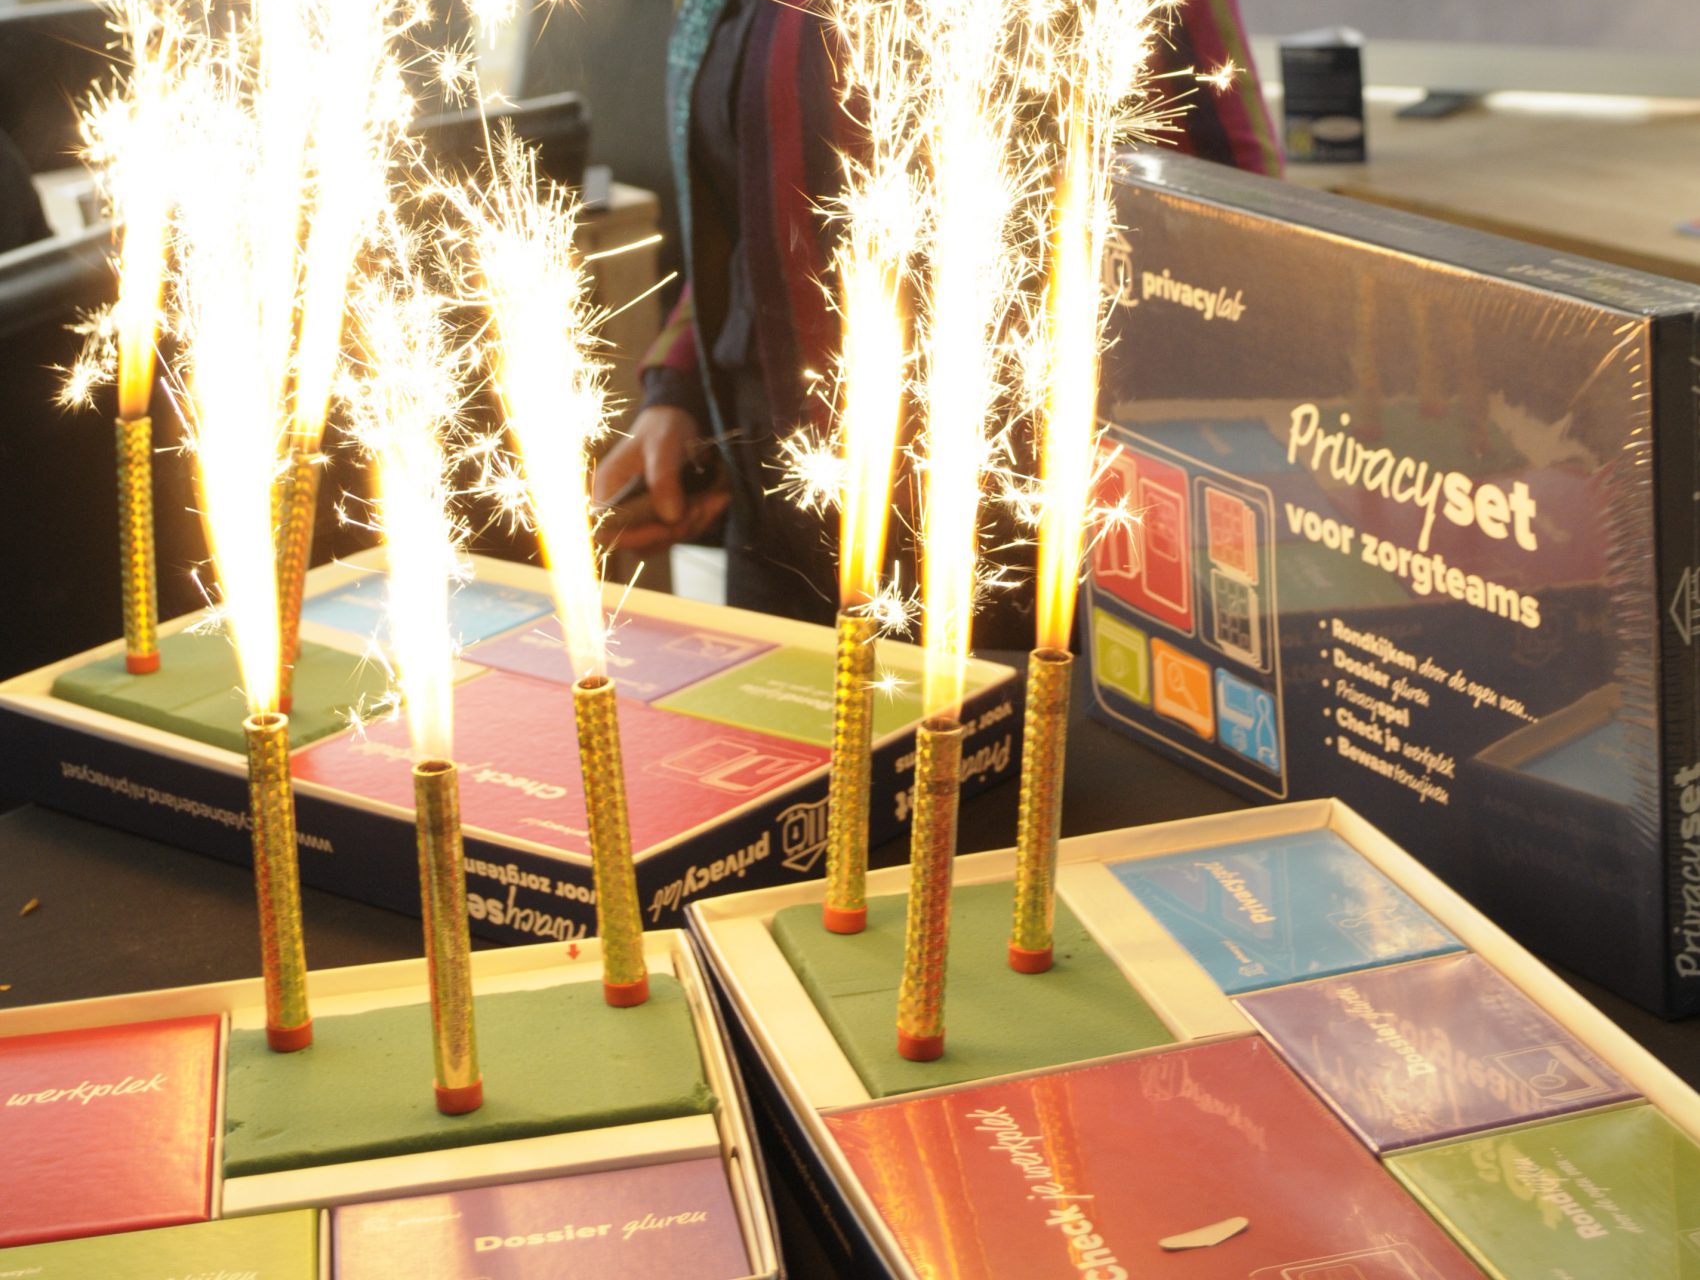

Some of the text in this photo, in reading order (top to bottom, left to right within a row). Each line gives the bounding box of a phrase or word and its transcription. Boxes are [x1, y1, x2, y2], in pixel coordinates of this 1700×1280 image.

[1141, 268, 1247, 322] privacylab
[1286, 402, 1538, 553] Privacyset
[1284, 502, 1542, 630] voor zorgteams
[1332, 618, 1417, 672] Rondkijken
[1333, 647, 1391, 689] Dossier
[1335, 678, 1411, 728] Privacyspel
[1335, 707, 1383, 746] Check
[1384, 727, 1400, 753] je
[473, 768, 567, 800] Check
[647, 830, 771, 923] privacylab
[1370, 1020, 1438, 1077] Dossier
[6, 1072, 169, 1107] werkplek
[965, 1105, 1053, 1180] werkplek
[1026, 1181, 1095, 1201] je
[473, 1209, 708, 1253] Dossier gluren
